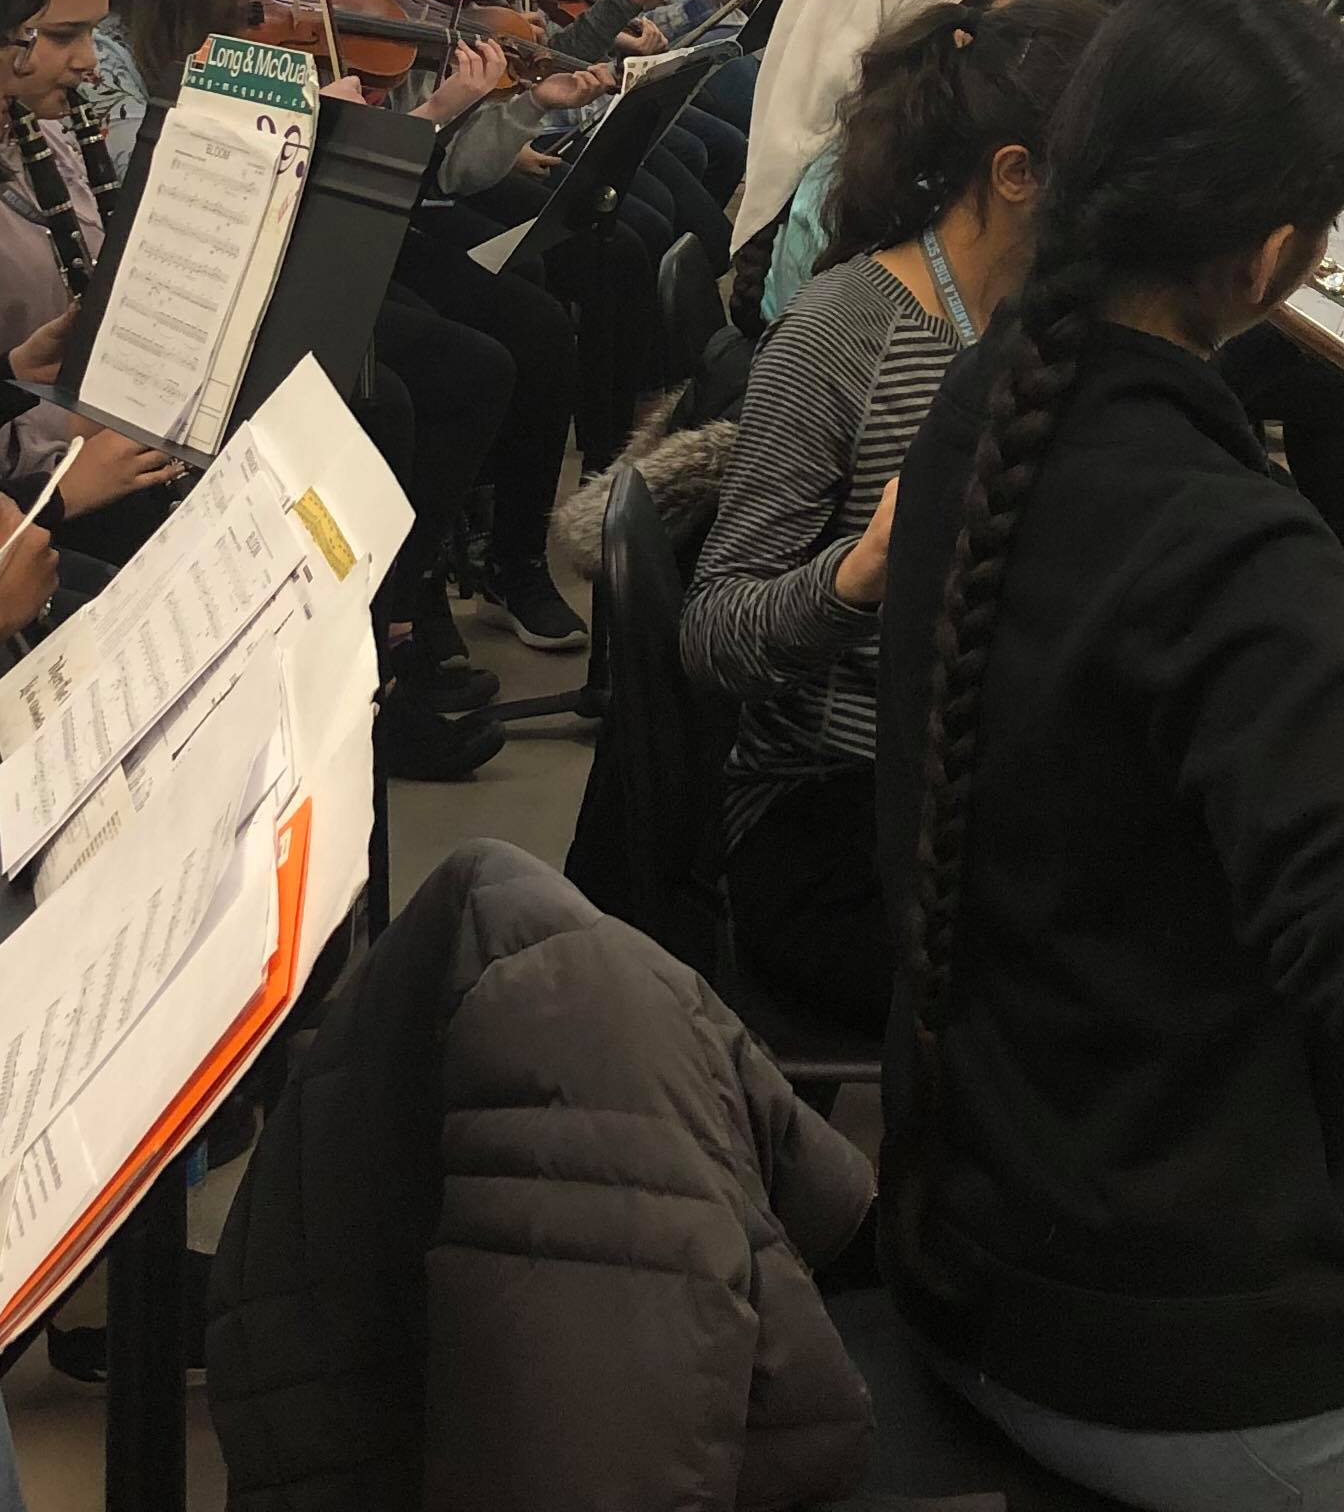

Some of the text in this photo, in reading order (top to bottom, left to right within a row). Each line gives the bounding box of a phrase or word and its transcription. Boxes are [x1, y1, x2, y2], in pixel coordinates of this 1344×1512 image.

[207, 38, 306, 85] Long & McQua
[186, 73, 306, 109] ong-mcquade.co
[931, 256, 952, 285] HIGH
[943, 284, 975, 338] MANDELA
